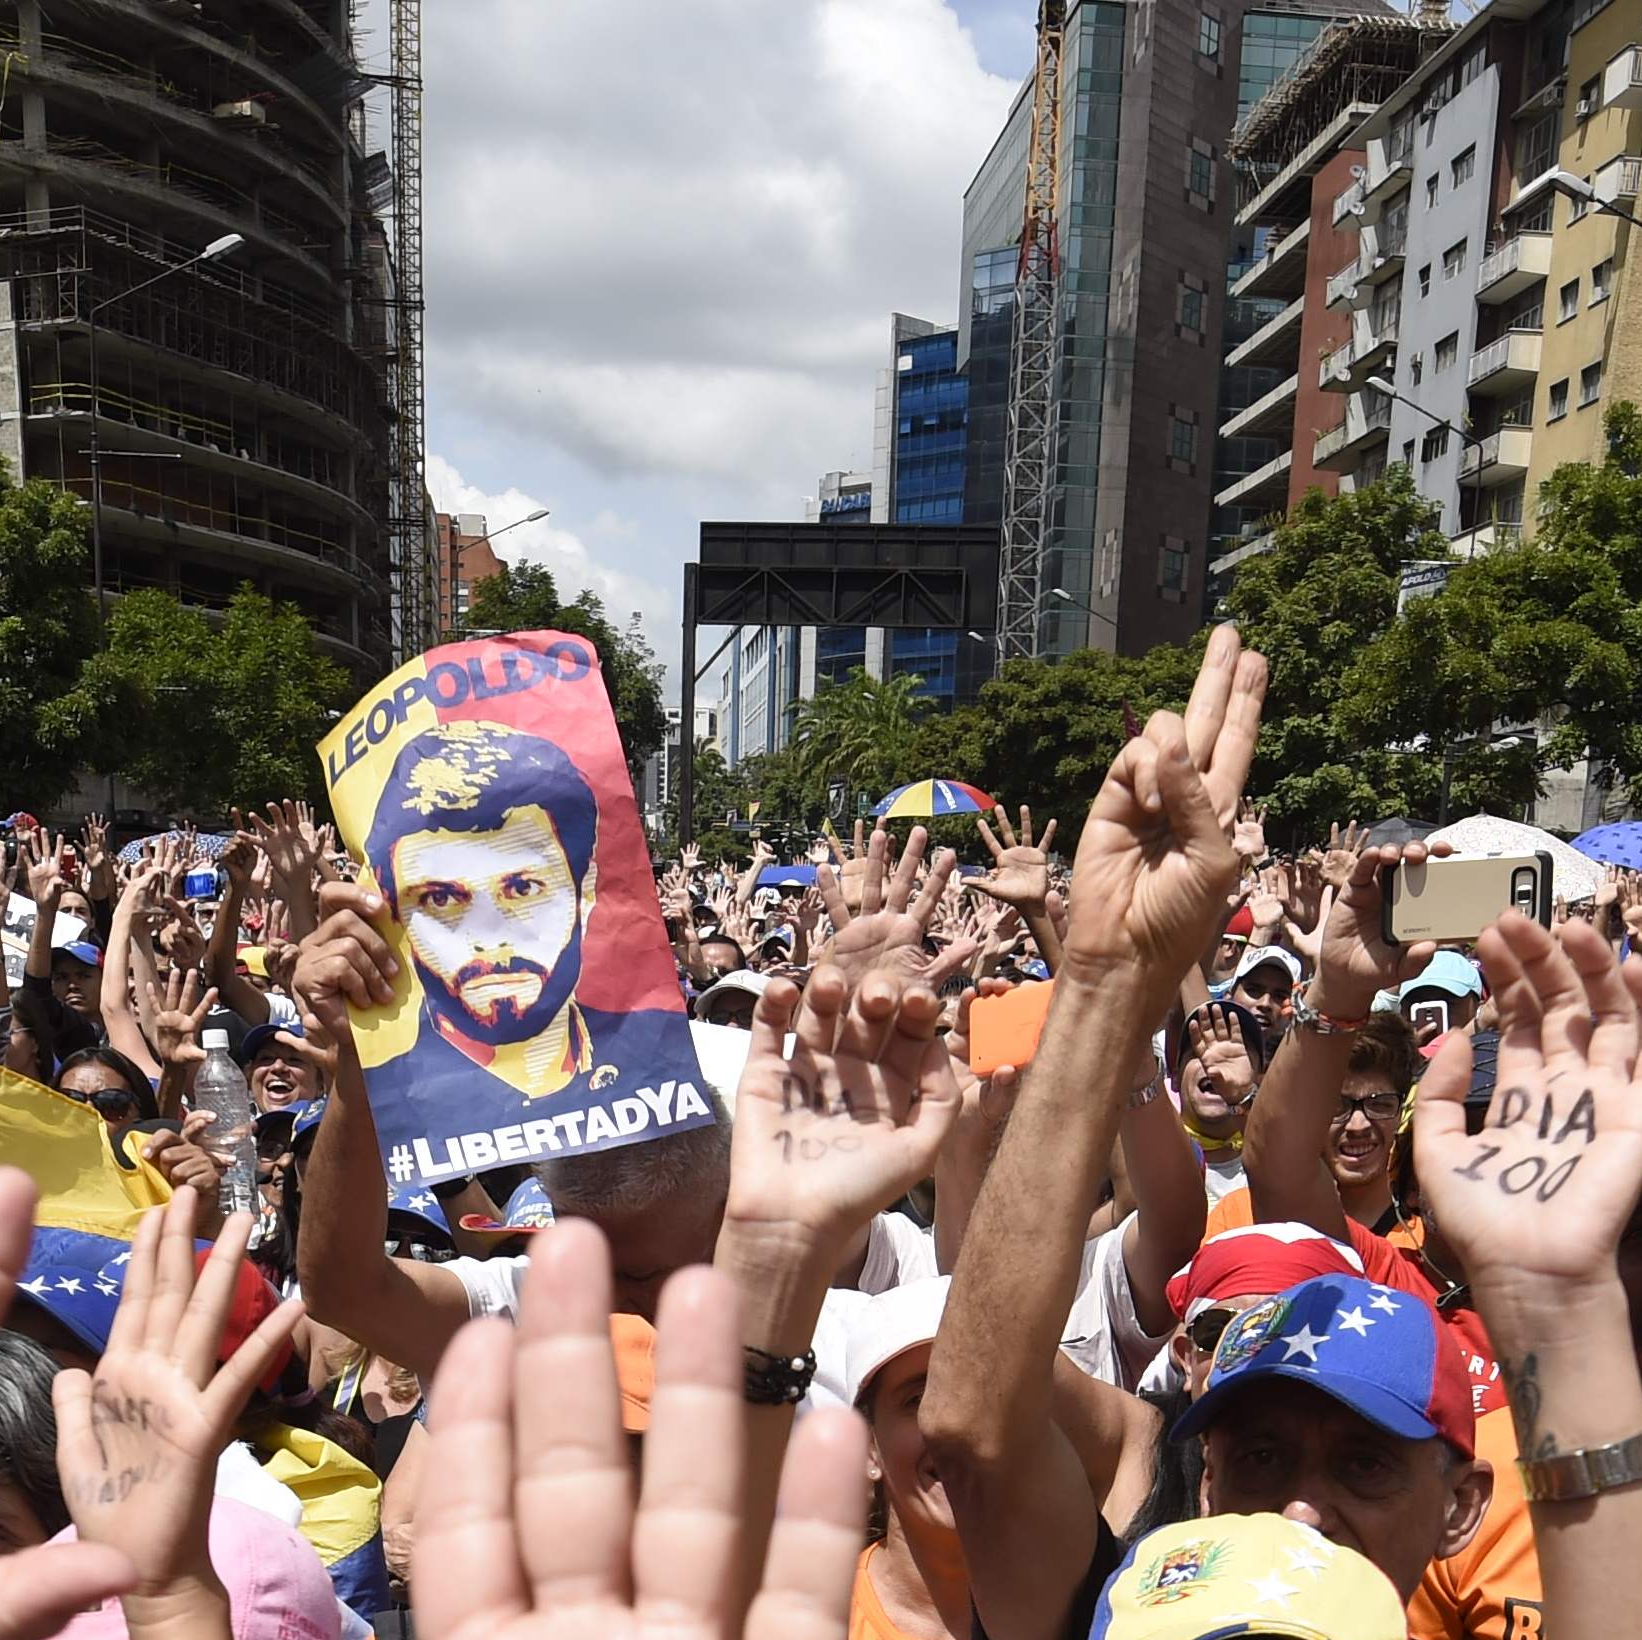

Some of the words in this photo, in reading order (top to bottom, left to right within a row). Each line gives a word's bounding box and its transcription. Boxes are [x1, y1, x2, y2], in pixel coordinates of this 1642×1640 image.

[328, 641, 592, 790] LEOPOLDO
[388, 1080, 711, 1182] #LIBERTADYA
[1453, 1144, 1583, 1203] 100
